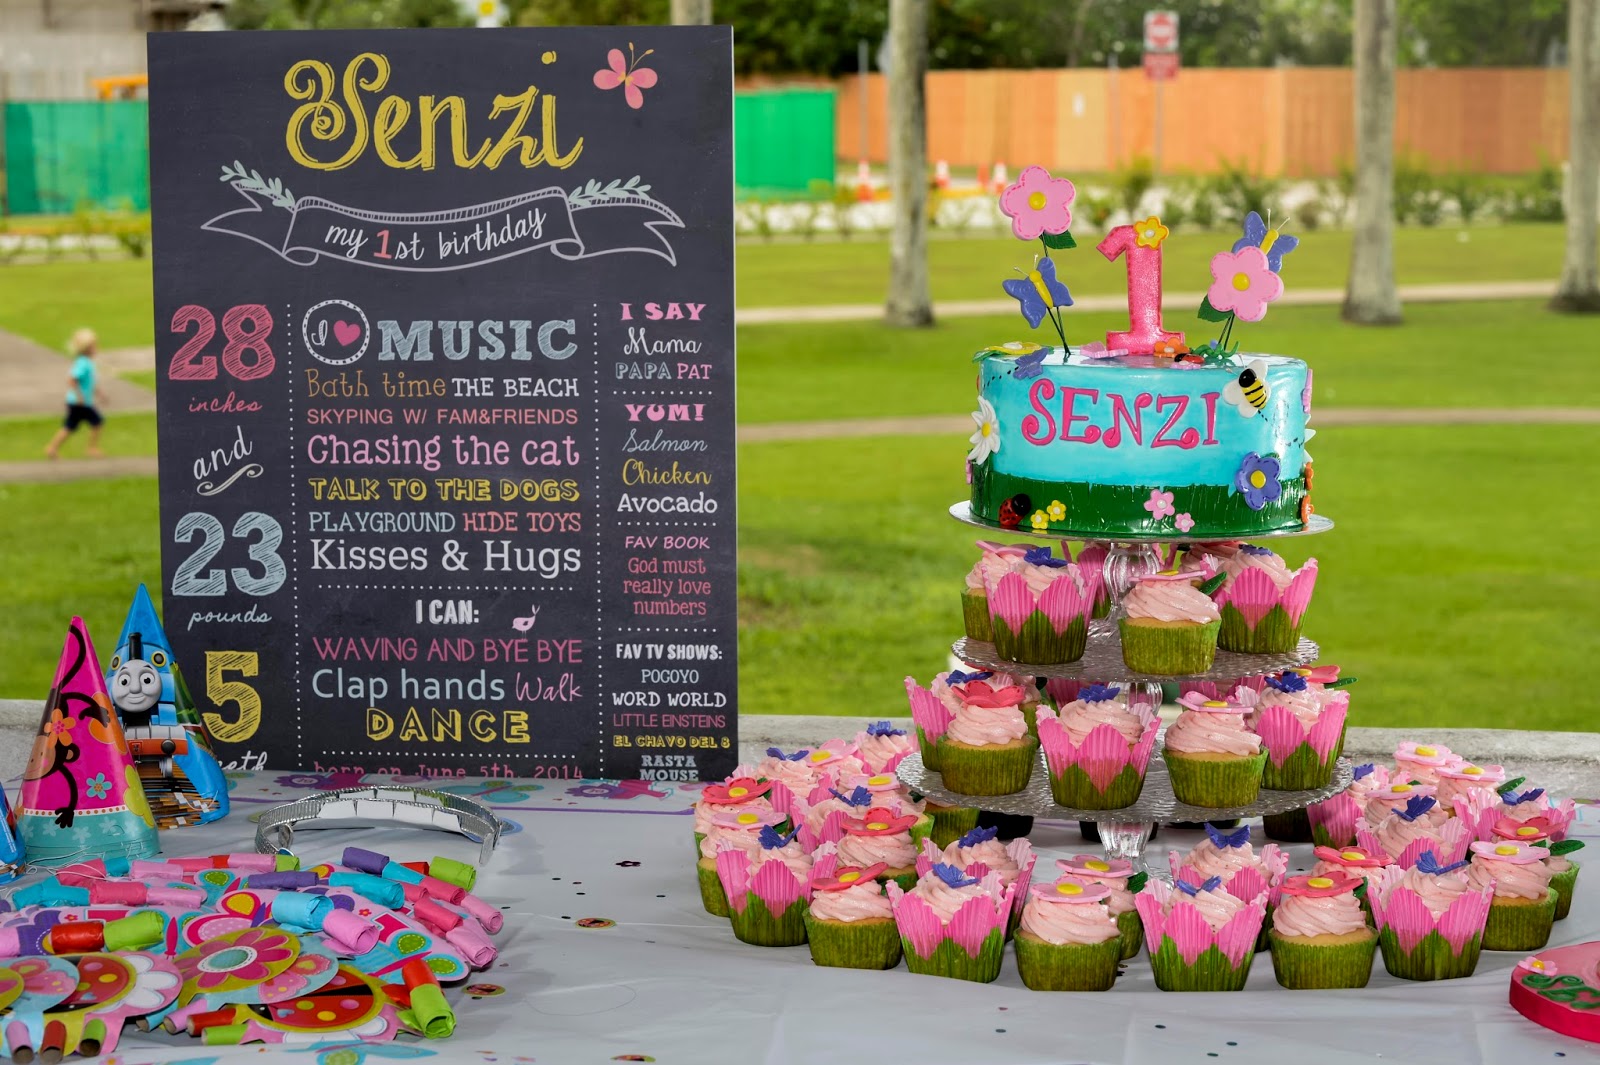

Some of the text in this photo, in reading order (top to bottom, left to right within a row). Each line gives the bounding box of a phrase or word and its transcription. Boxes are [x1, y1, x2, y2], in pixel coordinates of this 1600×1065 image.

[284, 51, 583, 171] Senzi
[325, 208, 547, 260] my 1st birthday
[1096, 223, 1186, 355] 1
[645, 303, 705, 320] SAY
[168, 304, 275, 381] 28
[377, 319, 577, 361] MUSIC
[624, 327, 702, 355] Mama
[616, 362, 712, 379] PAPA PAT
[305, 369, 579, 397] Bath time THE BEACH
[189, 391, 262, 412] inches
[625, 404, 704, 421] YUM!
[1021, 378, 1219, 449] SENZI
[308, 409, 577, 424] SKYPING W/ FAM&FRIENDS
[622, 428, 708, 452] Salmon
[194, 425, 254, 480] and
[308, 434, 579, 471] Chasing the cat
[623, 459, 711, 485] Chicken
[309, 477, 580, 501] TALK TO THE DOGS
[617, 492, 717, 513] Avocado
[309, 511, 581, 533] PLAYGROUND HIDE TOYS
[171, 512, 286, 596] 23
[625, 536, 710, 549] FAV BOOK
[311, 539, 581, 579] Kisses & Hugs
[628, 557, 706, 574] God must
[624, 579, 711, 597] really love
[188, 604, 272, 631] pounds
[429, 600, 479, 624] CAN:
[634, 599, 706, 615] numbers
[313, 637, 582, 663] WAVING AND BYE BYE
[616, 644, 722, 660] FAV TV SHOWS:
[312, 668, 582, 707] Clap hands Walk
[642, 669, 699, 683] POCOYO
[203, 651, 261, 742] 5
[612, 691, 726, 707] WORD WORLD
[367, 708, 530, 743] DANCE
[614, 713, 725, 728] LITTLE EINSTEINS
[613, 735, 730, 748] EL CHAVO DEL 8
[534, 765, 583, 780] 2014
[642, 755, 696, 767] RASTA
[640, 769, 698, 781] MOUSE
